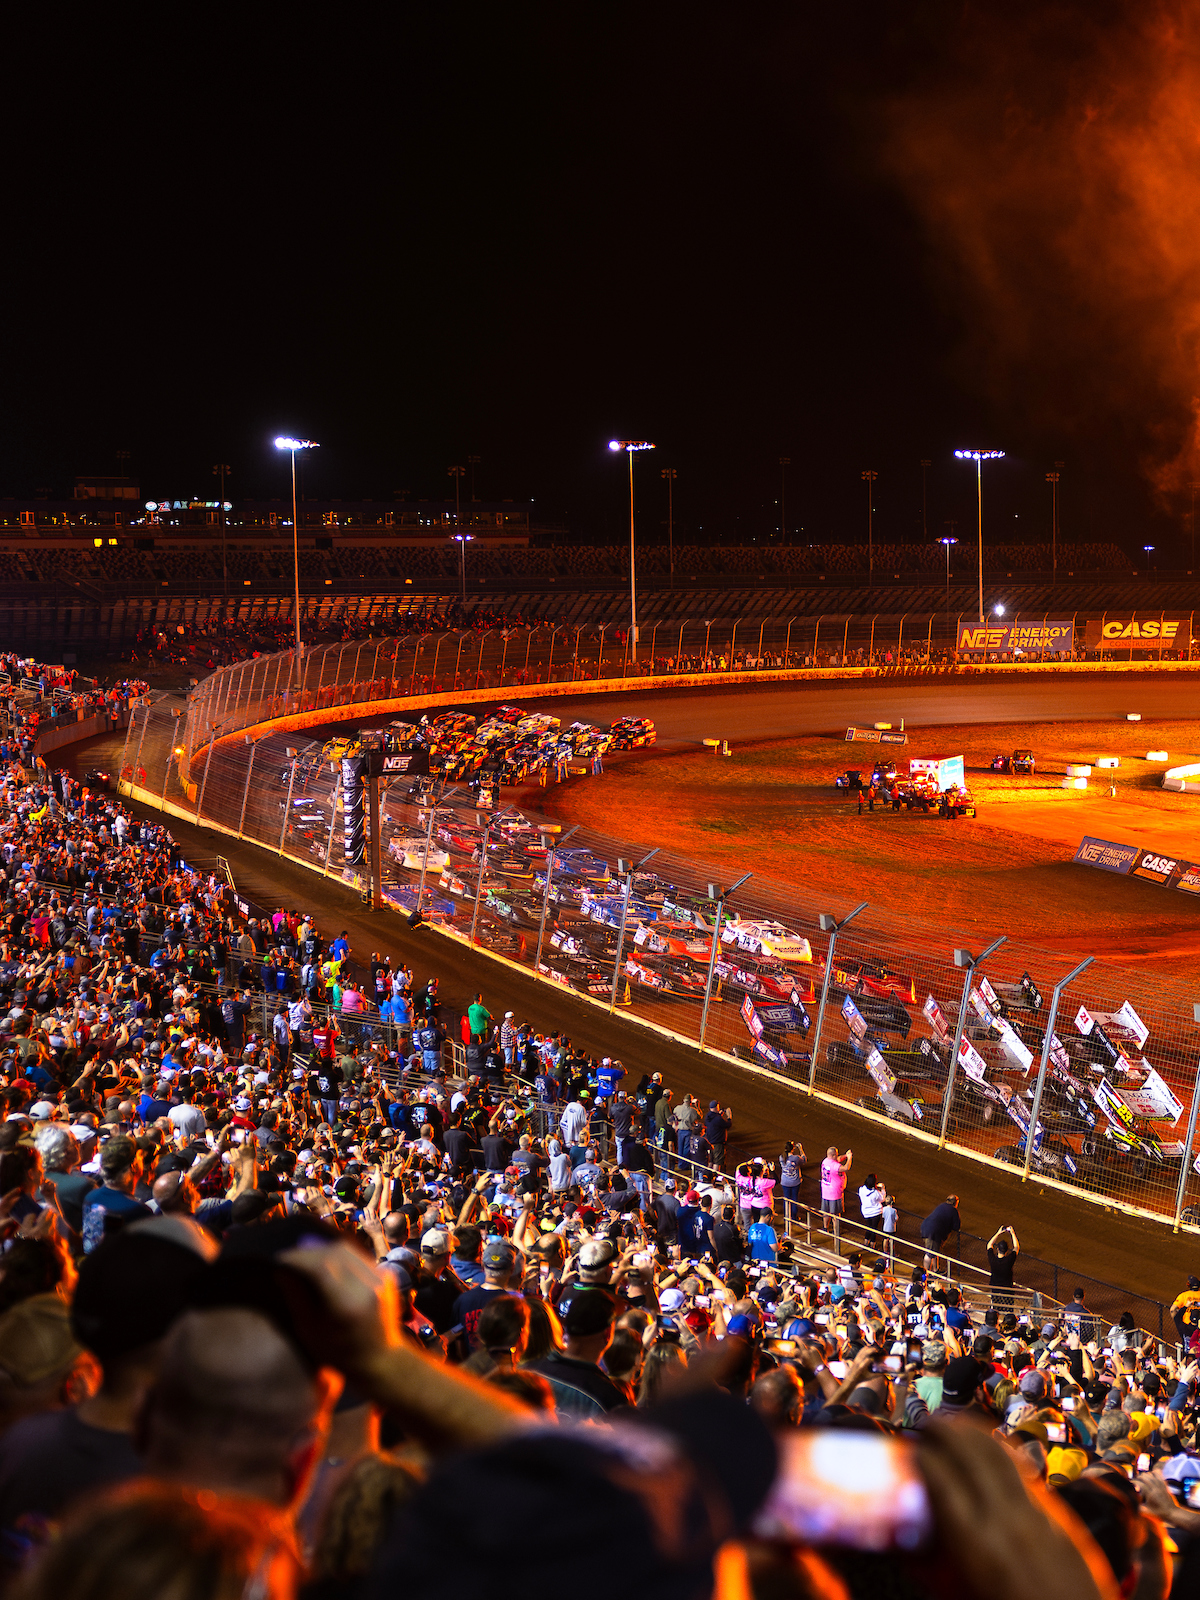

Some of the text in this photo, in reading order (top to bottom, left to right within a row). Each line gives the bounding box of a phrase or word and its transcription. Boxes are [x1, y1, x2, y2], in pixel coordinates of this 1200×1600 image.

[959, 625, 1070, 649] NOS ENERGY
[1103, 621, 1180, 638] CASE
[1007, 638, 1054, 648] DRINK
[383, 756, 412, 768] NOS
[1078, 844, 1133, 862] NOS ENERGY
[1098, 855, 1121, 868] DRINK
[1141, 854, 1176, 875] CASE
[836, 970, 846, 984] 97
